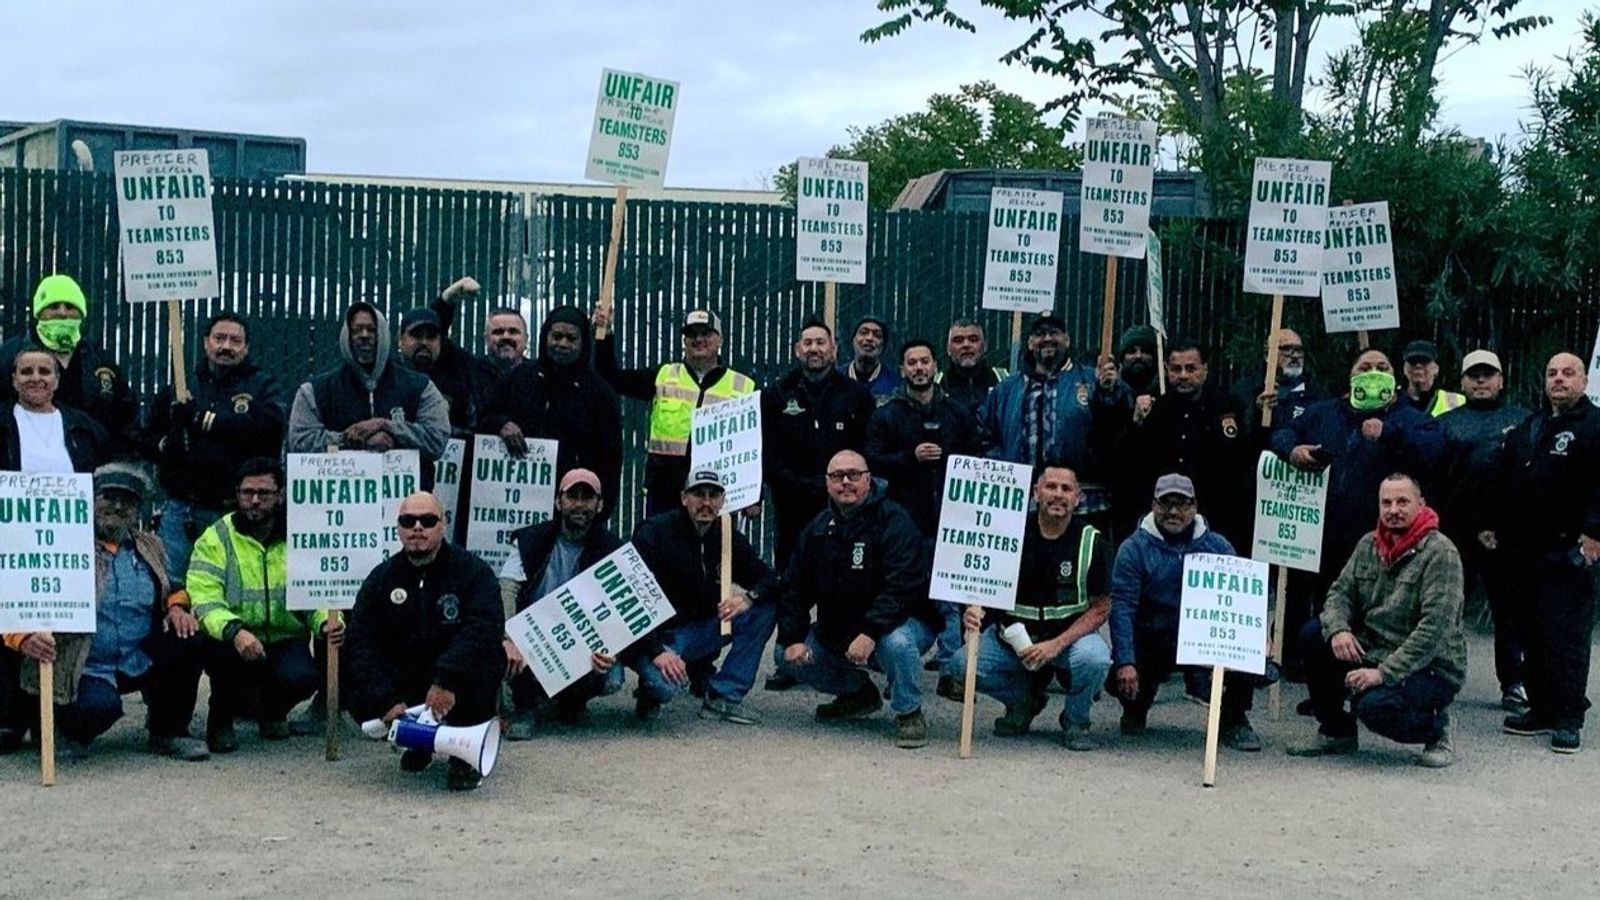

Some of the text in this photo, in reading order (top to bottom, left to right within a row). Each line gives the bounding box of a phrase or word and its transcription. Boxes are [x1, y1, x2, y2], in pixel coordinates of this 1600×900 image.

[605, 73, 674, 109] UNFAIR
[630, 106, 642, 120] TO
[599, 118, 667, 145] TEAMSTERS
[618, 142, 639, 160] 853
[1088, 140, 1151, 166] UNFAIR
[120, 154, 198, 167] PREMIER
[1111, 169, 1123, 184] TO
[123, 175, 206, 200] UNFAIR
[803, 177, 864, 201] UNFAIR
[1085, 186, 1147, 206] TEAMSTERS
[1257, 180, 1325, 205] UNFAIR
[158, 205, 175, 221] TO
[827, 204, 840, 216] TO
[1103, 209, 1124, 224] 853
[1283, 209, 1297, 224] TO
[1330, 208, 1377, 218] EMIER
[801, 220, 863, 236] TEAMSTERS
[994, 208, 1057, 231] UNFAIR
[127, 226, 210, 244] TEAMSTERS
[1018, 234, 1030, 247] TO
[1253, 227, 1321, 245] TEAMSTERS
[821, 240, 842, 253] 853
[156, 250, 184, 265] 853
[991, 249, 1054, 266] TEAMSTERS
[1274, 249, 1298, 263] 853
[1348, 252, 1362, 265] TO
[1010, 270, 1031, 283] 853
[1324, 267, 1391, 285] TEAMSTERS
[1348, 288, 1370, 301] 853
[696, 410, 757, 445] UNFAIR
[482, 439, 545, 454] PREER
[720, 440, 732, 453] TO
[300, 457, 355, 467] PREMIER
[696, 449, 758, 470] MSTERS
[954, 457, 1013, 474] PREMIER
[477, 458, 551, 485] UNFAIR
[722, 472, 736, 486] 53
[0, 475, 78, 490] PREMIER
[382, 474, 415, 498] AIR
[292, 479, 377, 504] UNFAIR
[505, 488, 520, 503] TO
[949, 478, 1024, 512] UNFAIR
[0, 498, 88, 524] UNFAIR
[326, 510, 344, 526] TO
[474, 507, 549, 524] TEAMSTERS
[976, 511, 991, 527] TO
[1261, 499, 1320, 525] TEAMSTERS
[35, 529, 54, 546] TO
[496, 530, 511, 545] 85
[1278, 523, 1296, 540] 853
[292, 533, 377, 549] TEAMSTERS
[943, 528, 1019, 553] TEAMSTERS
[0, 553, 90, 570] TEAMSTERS
[320, 556, 349, 572] 853
[964, 554, 990, 571] 853
[622, 548, 662, 604] PREMIER
[1188, 569, 1263, 596] UNFAIR
[31, 577, 61, 593] 853
[594, 559, 651, 636] UNFAIR
[1217, 594, 1232, 607] TO
[593, 601, 611, 622] TO
[1186, 608, 1262, 628] TEAMSTERS
[552, 623, 576, 651] 853
[1210, 627, 1236, 640] 853
